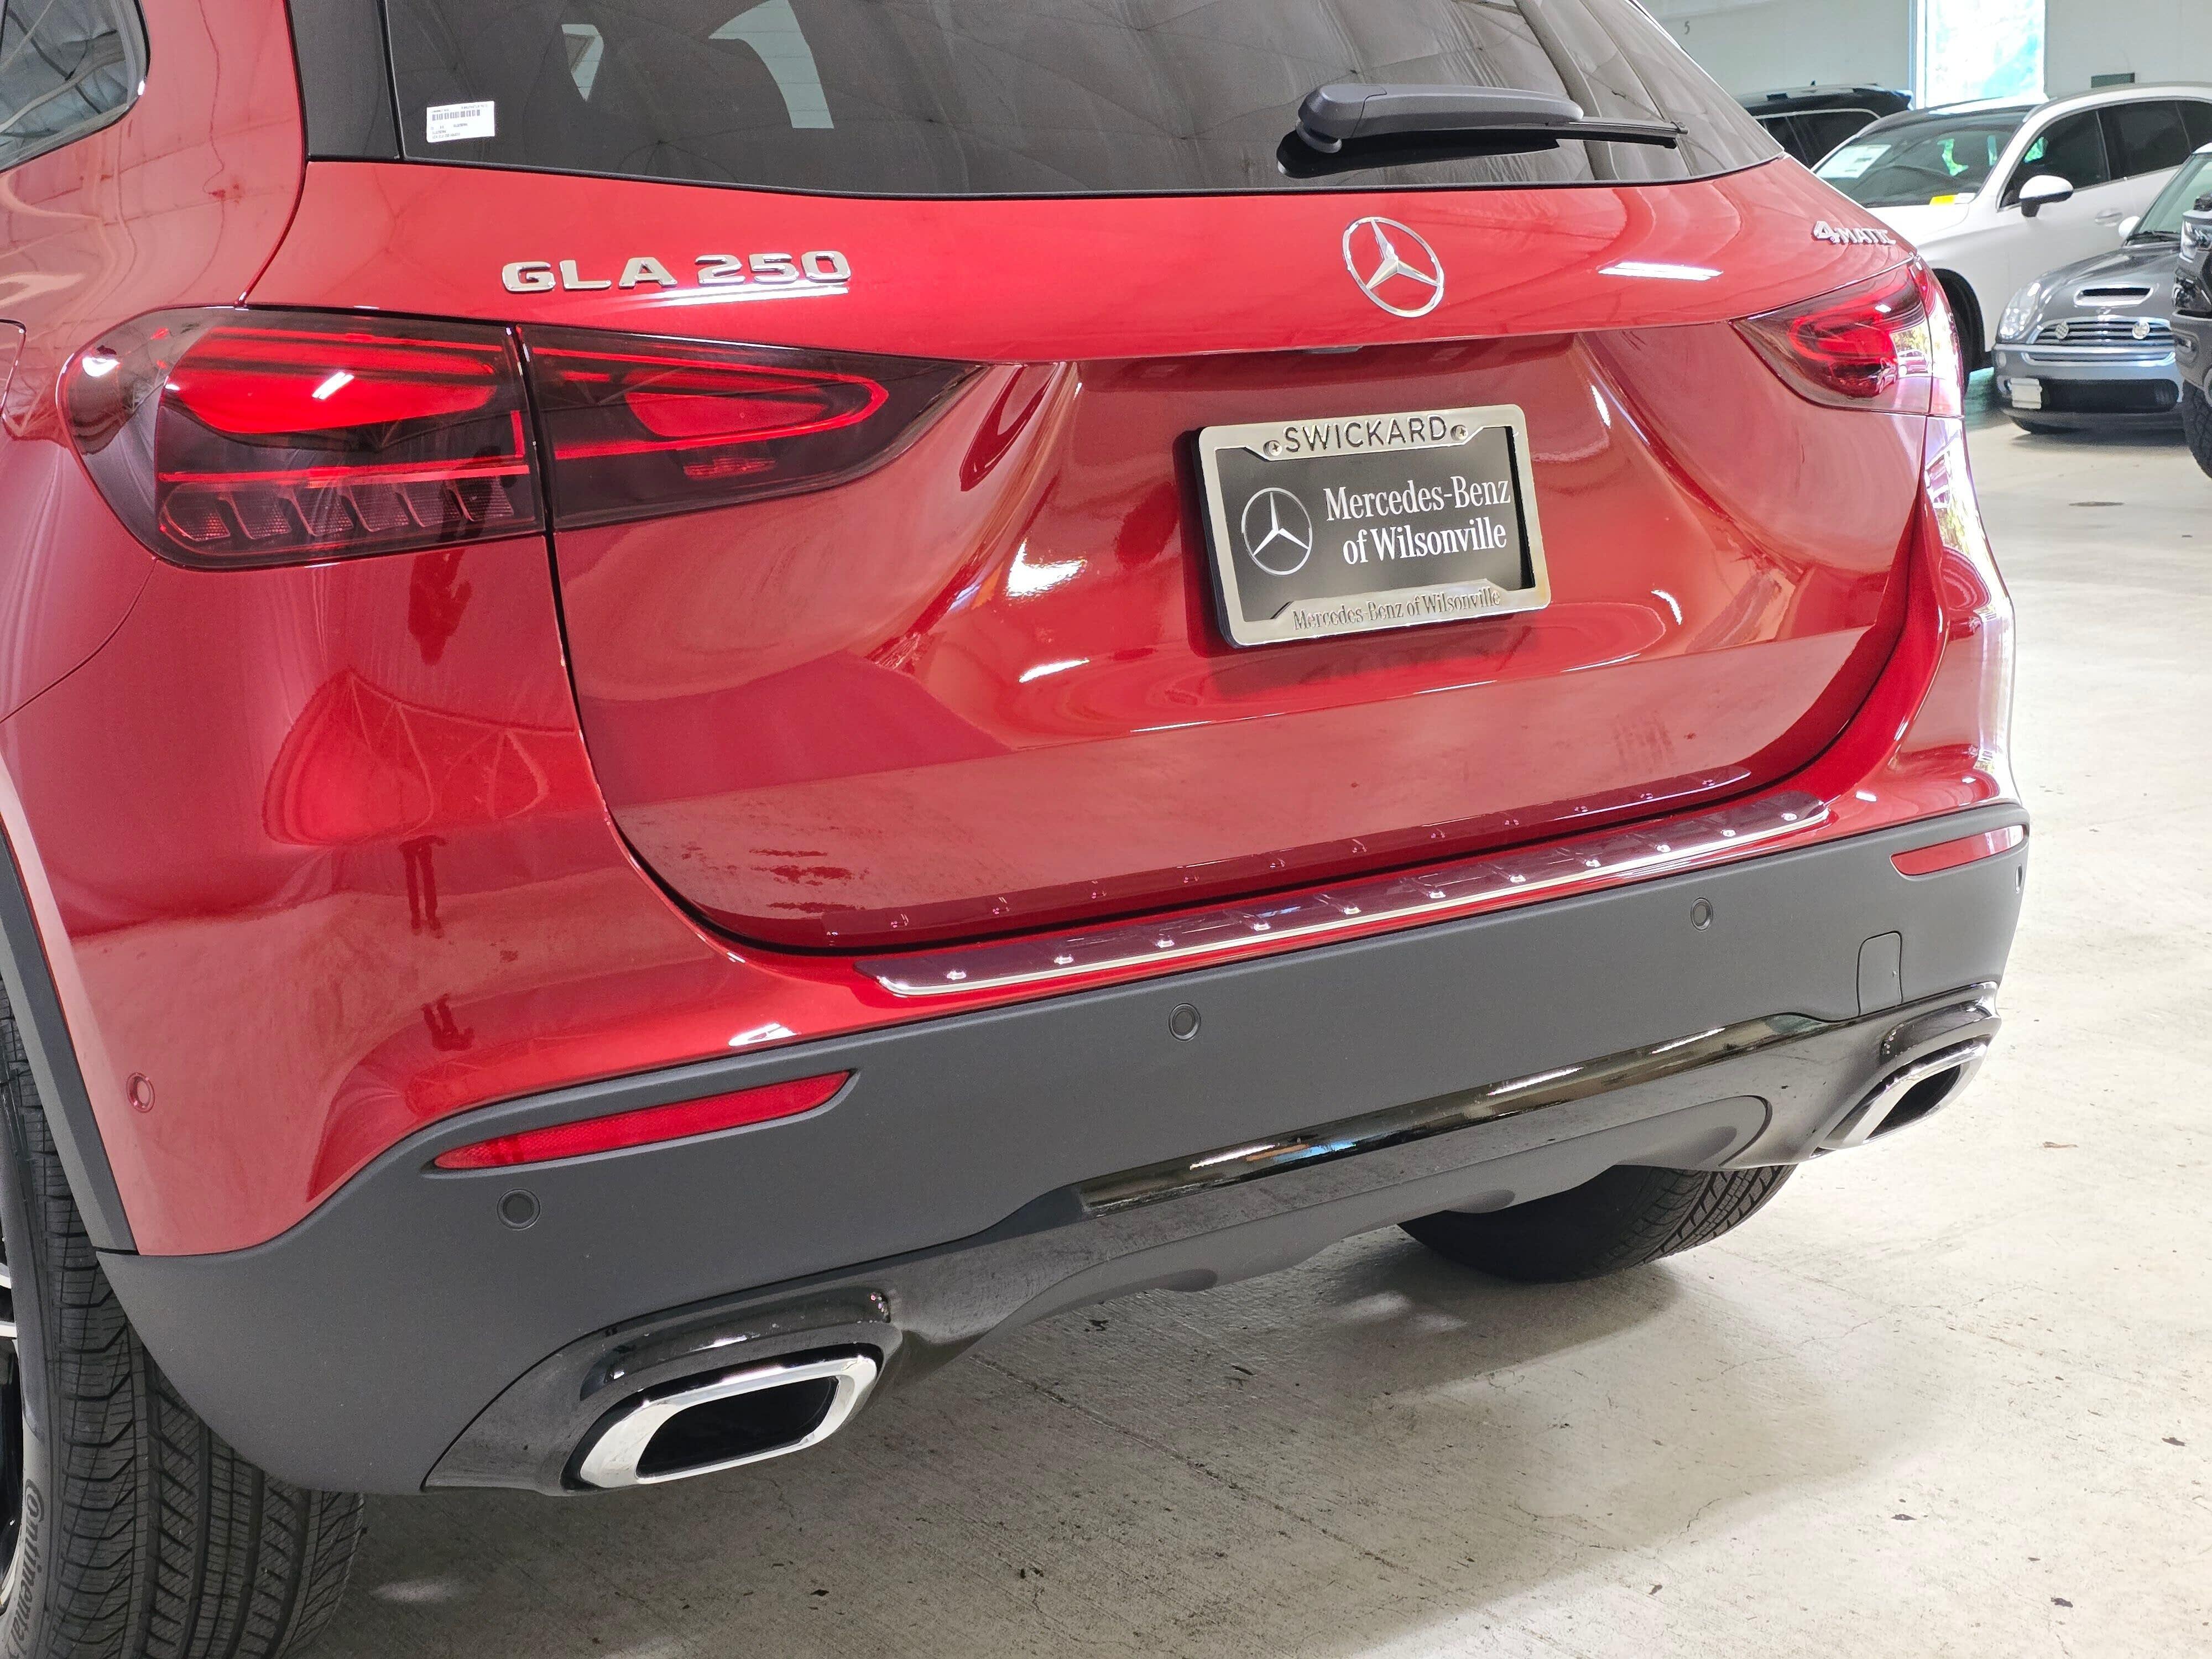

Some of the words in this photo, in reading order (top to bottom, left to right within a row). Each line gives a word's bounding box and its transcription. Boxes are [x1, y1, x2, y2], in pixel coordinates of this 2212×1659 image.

[502, 257, 678, 293] GLA
[695, 251, 852, 286] 250
[1283, 414, 1447, 453] SWICKARD
[1323, 475, 1511, 521] Mercedes-Benz
[1343, 529, 1368, 565] of
[1370, 517, 1507, 561] Wilsonville
[1292, 601, 1404, 630] Mercedes-Benz
[1406, 596, 1421, 618] of
[1421, 587, 1501, 615] Wilsonville
[11, 1479, 45, 1656] Continental
